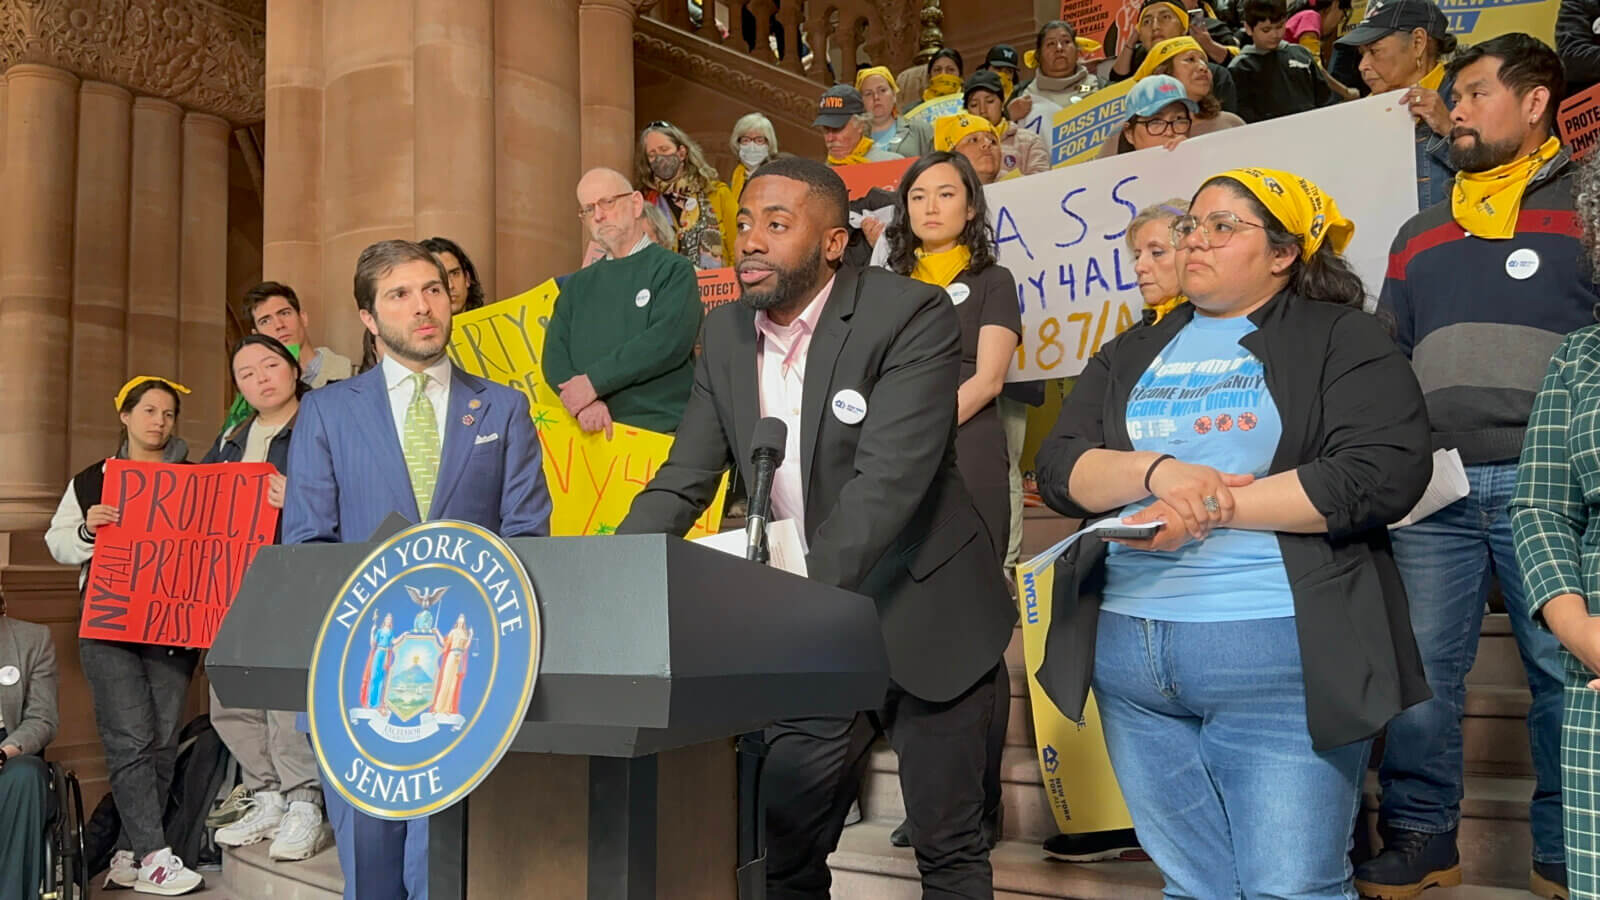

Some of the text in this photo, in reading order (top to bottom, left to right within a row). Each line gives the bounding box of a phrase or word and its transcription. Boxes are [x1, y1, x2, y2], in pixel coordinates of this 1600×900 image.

[1446, 15, 1466, 32] LL
[1058, 111, 1096, 141] PASS
[1565, 106, 1600, 135] PROTE
[1058, 136, 1087, 161] FOR
[995, 175, 1139, 261] ASS
[1018, 247, 1139, 315] Y4AL
[1205, 390, 1261, 413] DIGNITY
[336, 534, 523, 636] NEW YORK STATE
[1023, 572, 1039, 624] NYCLU
[143, 600, 195, 643] PASS
[345, 758, 443, 802] SENATE
[1049, 779, 1058, 794] FOR
[1055, 778, 1072, 821] NEW YORK
